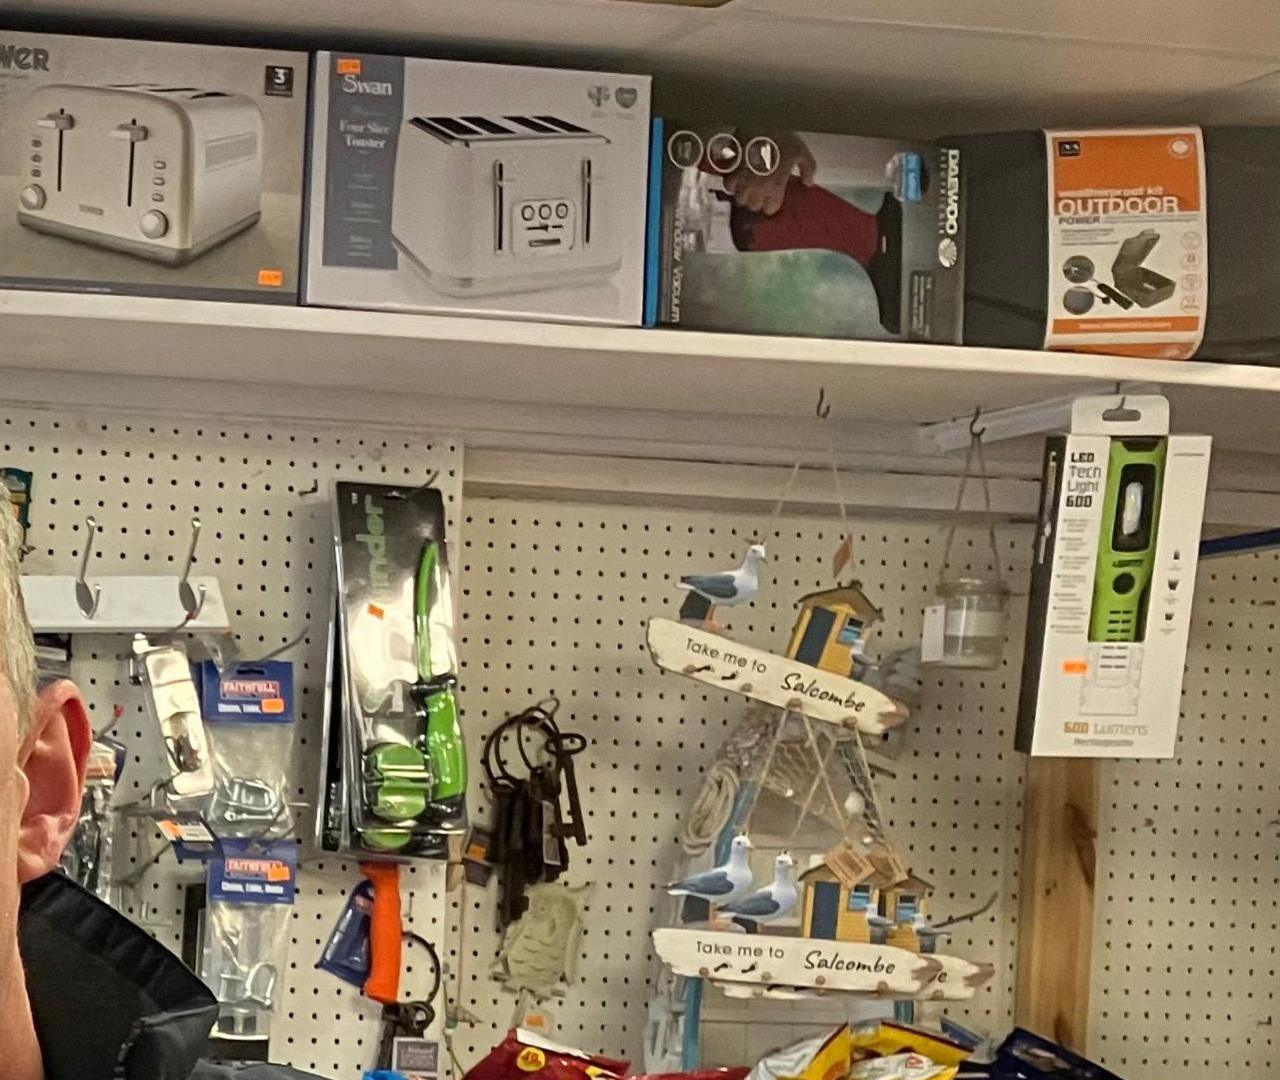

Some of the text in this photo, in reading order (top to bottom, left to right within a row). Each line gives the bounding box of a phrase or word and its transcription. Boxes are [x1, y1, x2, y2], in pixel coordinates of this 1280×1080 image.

[342, 74, 394, 97] Swan
[1057, 196, 1179, 217] OUTDOOR
[1058, 215, 1101, 226] POWER
[1070, 452, 1095, 463] LED
[1068, 466, 1102, 479] Tech
[1067, 480, 1100, 494] Light
[686, 638, 867, 714] Take me to Salcombe
[223, 681, 276, 694] FAITHFULL
[696, 940, 897, 975] Take me to Salcombe
